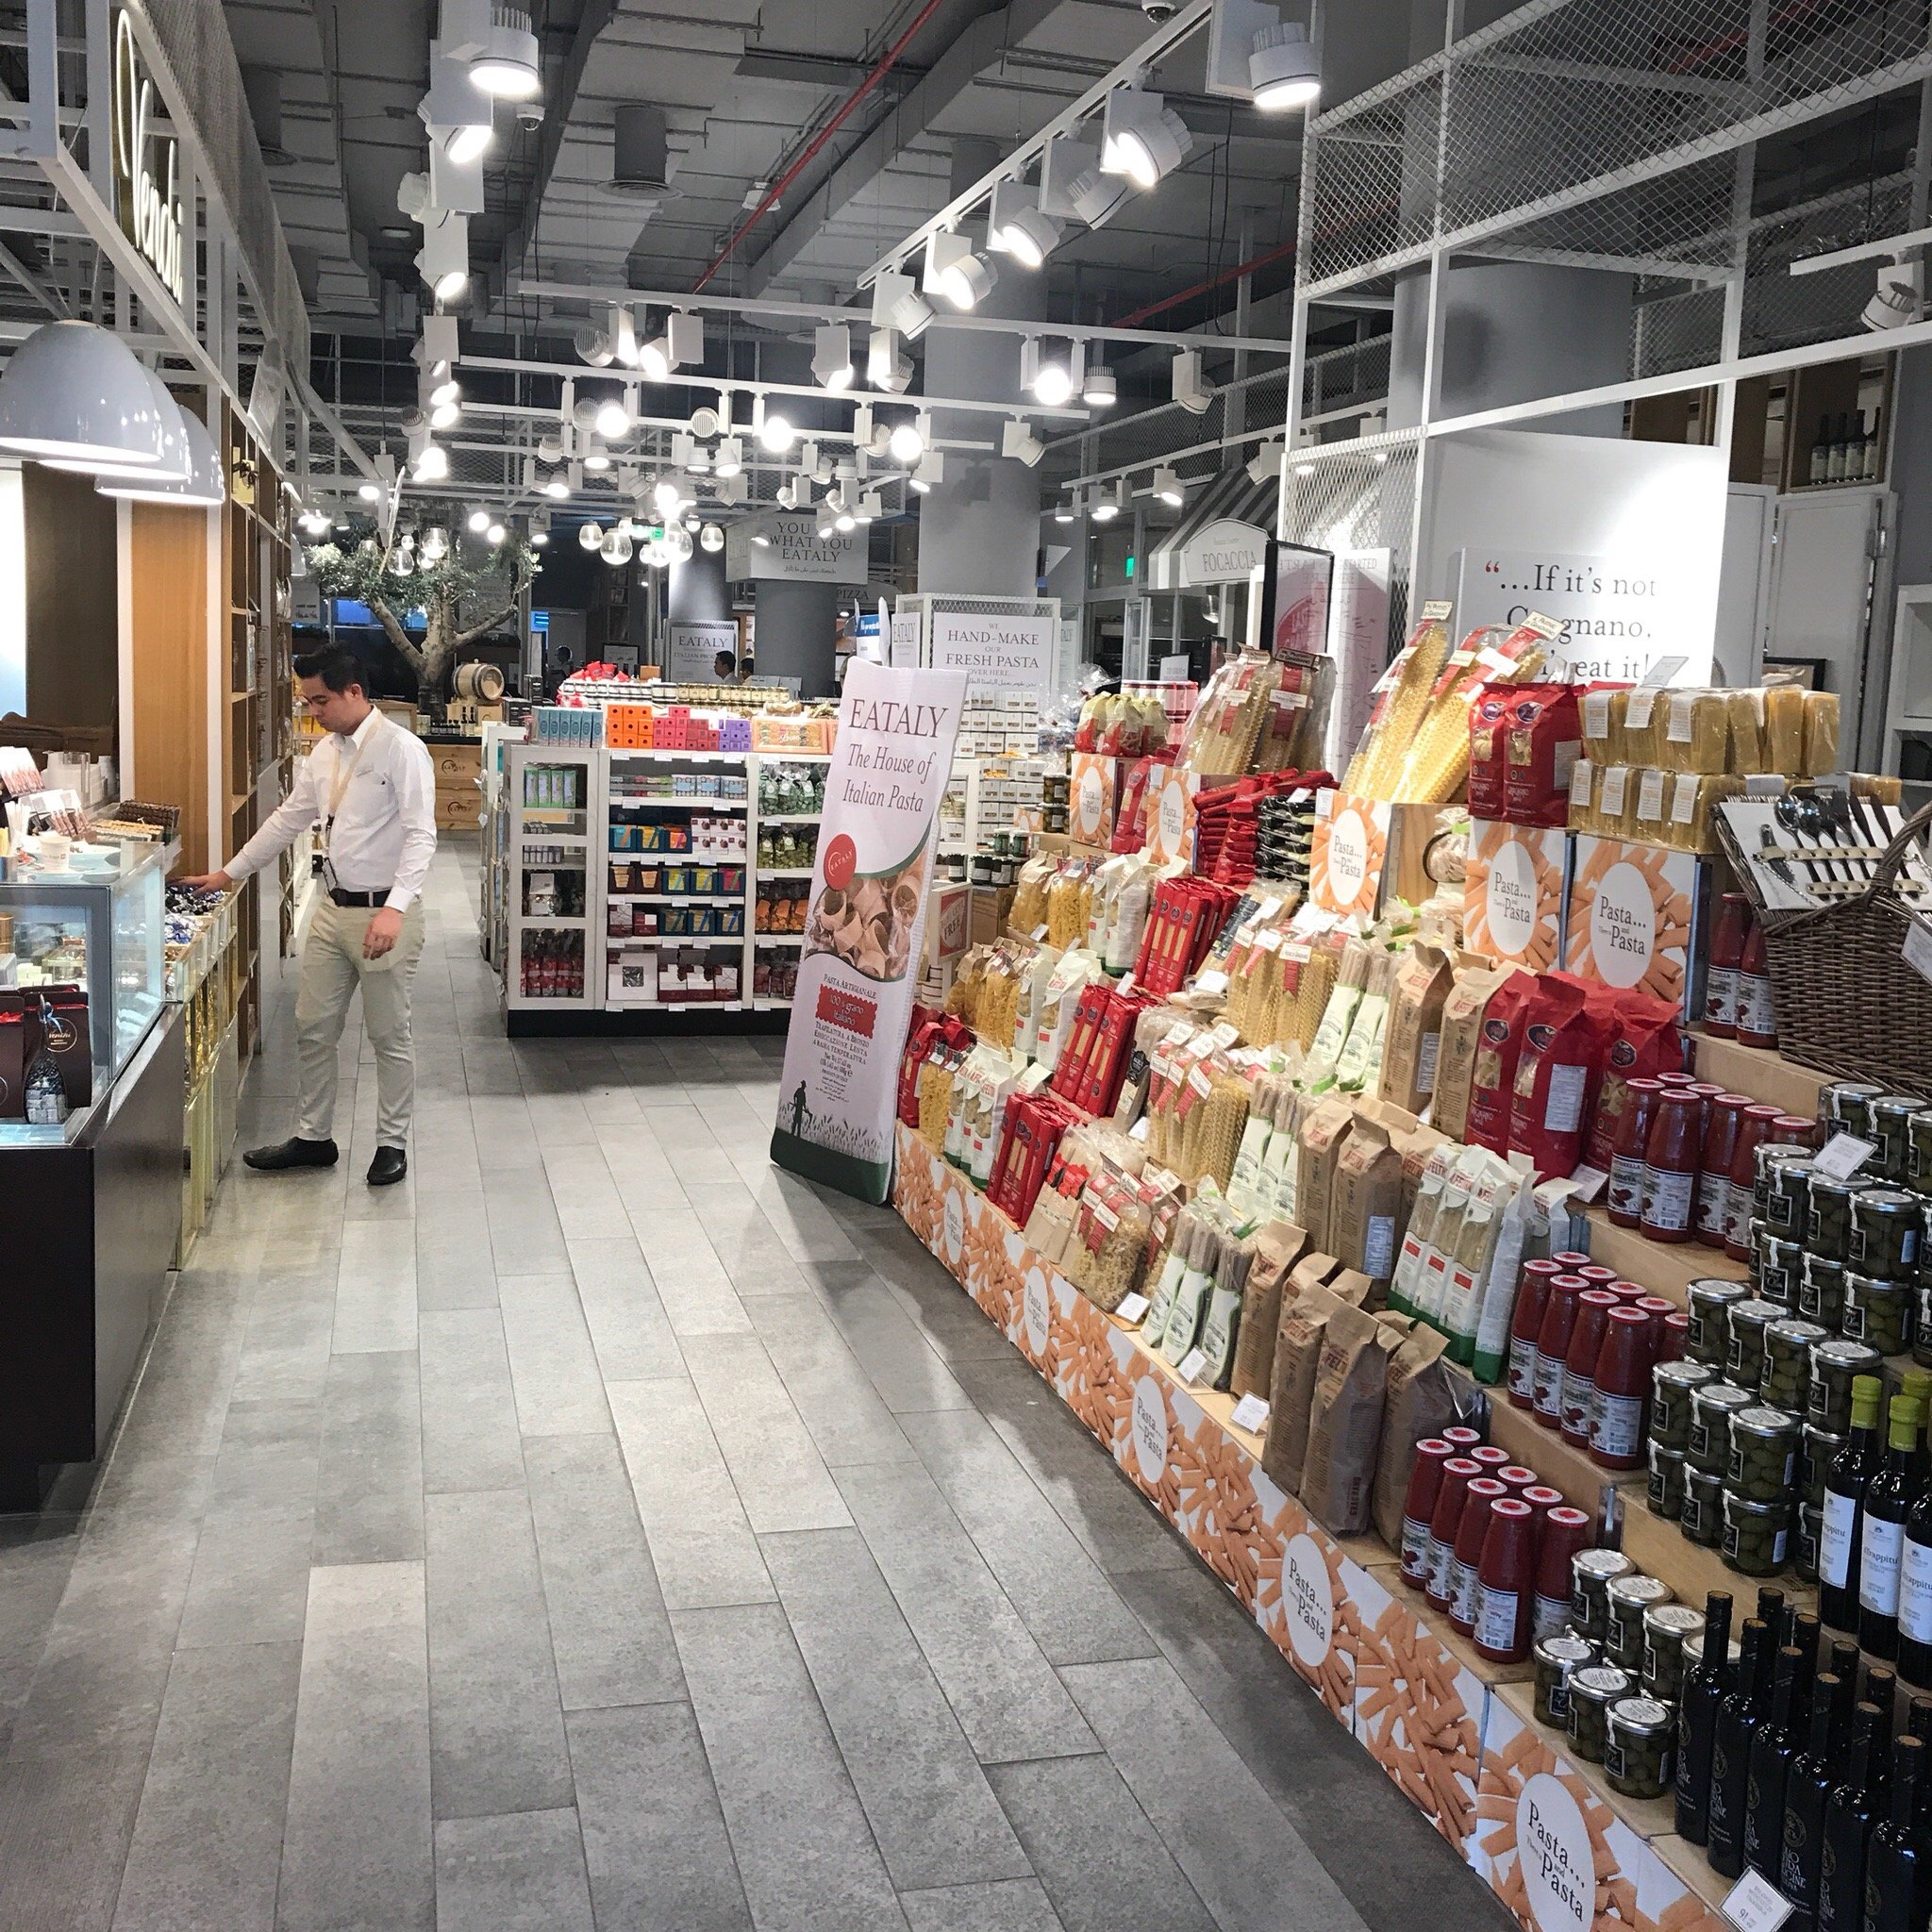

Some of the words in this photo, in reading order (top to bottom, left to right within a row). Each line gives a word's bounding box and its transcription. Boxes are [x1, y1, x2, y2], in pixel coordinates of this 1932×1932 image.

[117, 8, 183, 305] Venchi
[777, 522, 810, 535] YOU
[770, 535, 815, 548] WHAT
[821, 538, 853, 551] YOU
[781, 548, 841, 562] EATALY
[1203, 550, 1257, 573] FOCACCIA
[836, 589, 869, 600] PIZZA
[1612, 576, 1657, 597] not
[678, 635, 728, 648] EATALY
[893, 622, 916, 642] EATALY
[947, 629, 1040, 645] HAND-MAKE
[946, 653, 991, 666] FRESH
[996, 656, 1040, 669] PASTA
[1575, 658, 1611, 677] eat
[848, 698, 949, 739] EATALY
[848, 743, 870, 769] The
[872, 746, 913, 774] House
[917, 752, 937, 784] of
[842, 779, 885, 808] Italian
[888, 784, 924, 812] Pasta
[830, 850, 853, 871] EATALY
[1340, 858, 1361, 879] Pasta
[1504, 897, 1530, 924] Pasta
[1610, 924, 1645, 956] Pasta
[824, 974, 840, 988] PASTA
[840, 980, 876, 1000] ARTIGIANALE
[830, 994, 841, 1006] 100
[1143, 1425, 1162, 1461] Pasta
[1297, 1592, 1325, 1643] Pasta
[1541, 1848, 1583, 1923] Pasta
